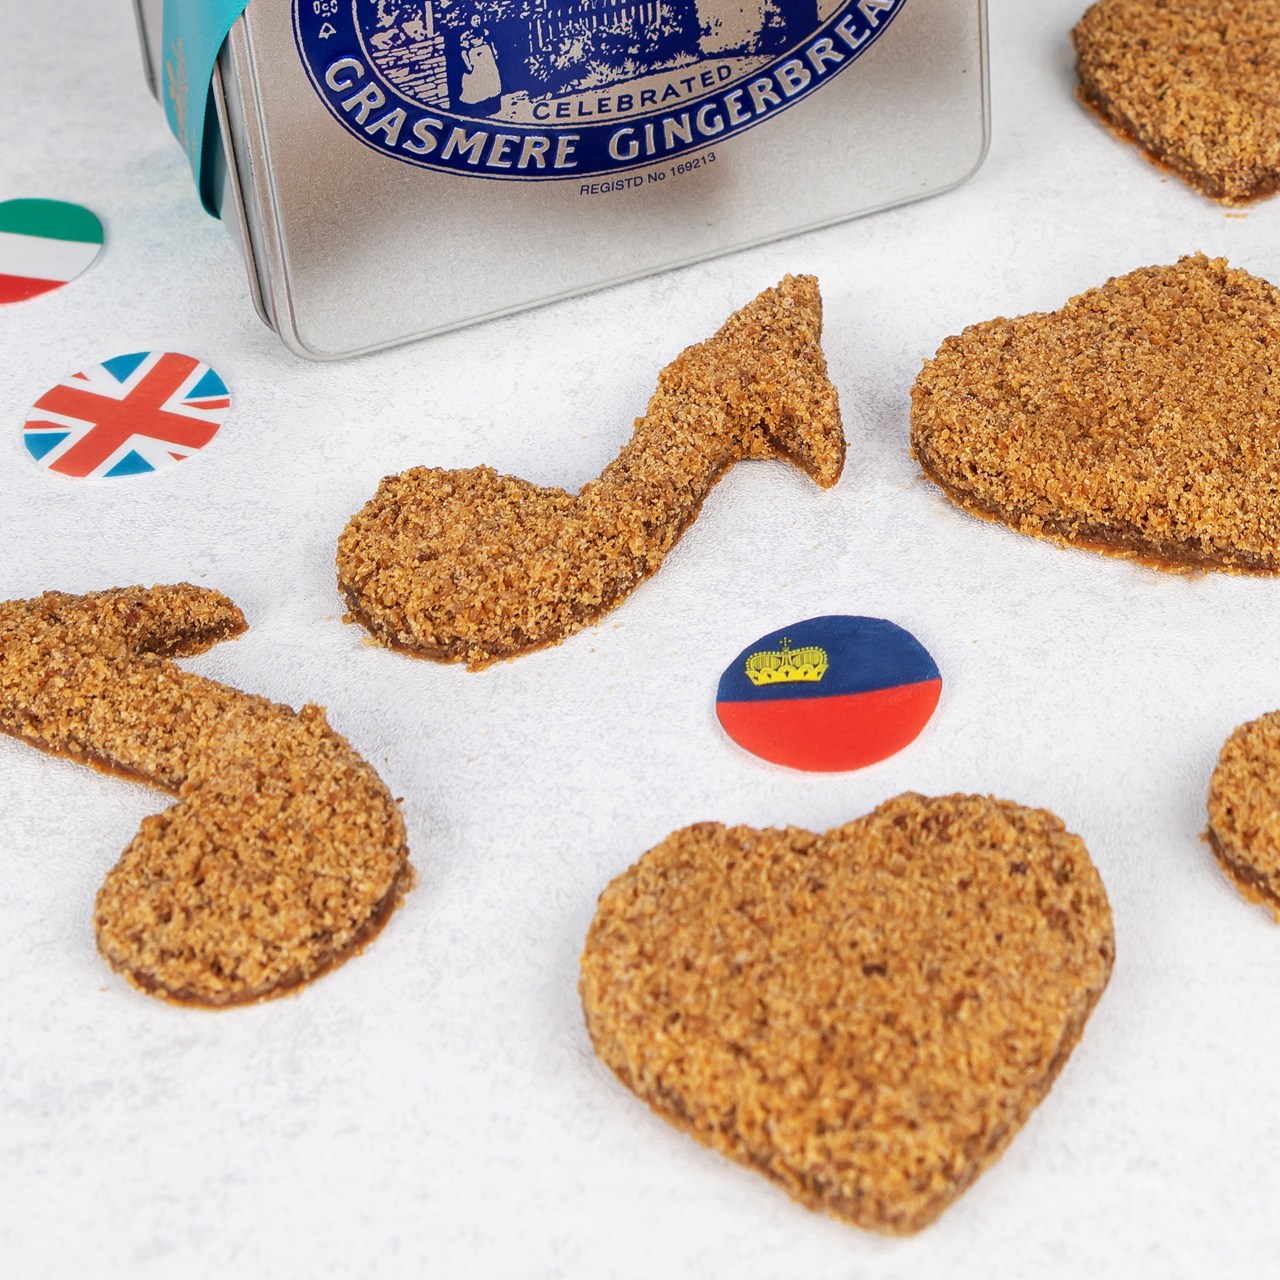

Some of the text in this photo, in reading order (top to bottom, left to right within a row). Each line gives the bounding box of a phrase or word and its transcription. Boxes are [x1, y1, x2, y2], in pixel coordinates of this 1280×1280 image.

[324, 57, 581, 169] GRASMERE
[532, 64, 733, 121] CELEBRATED
[580, 151, 717, 196] REGISTD No 169213
